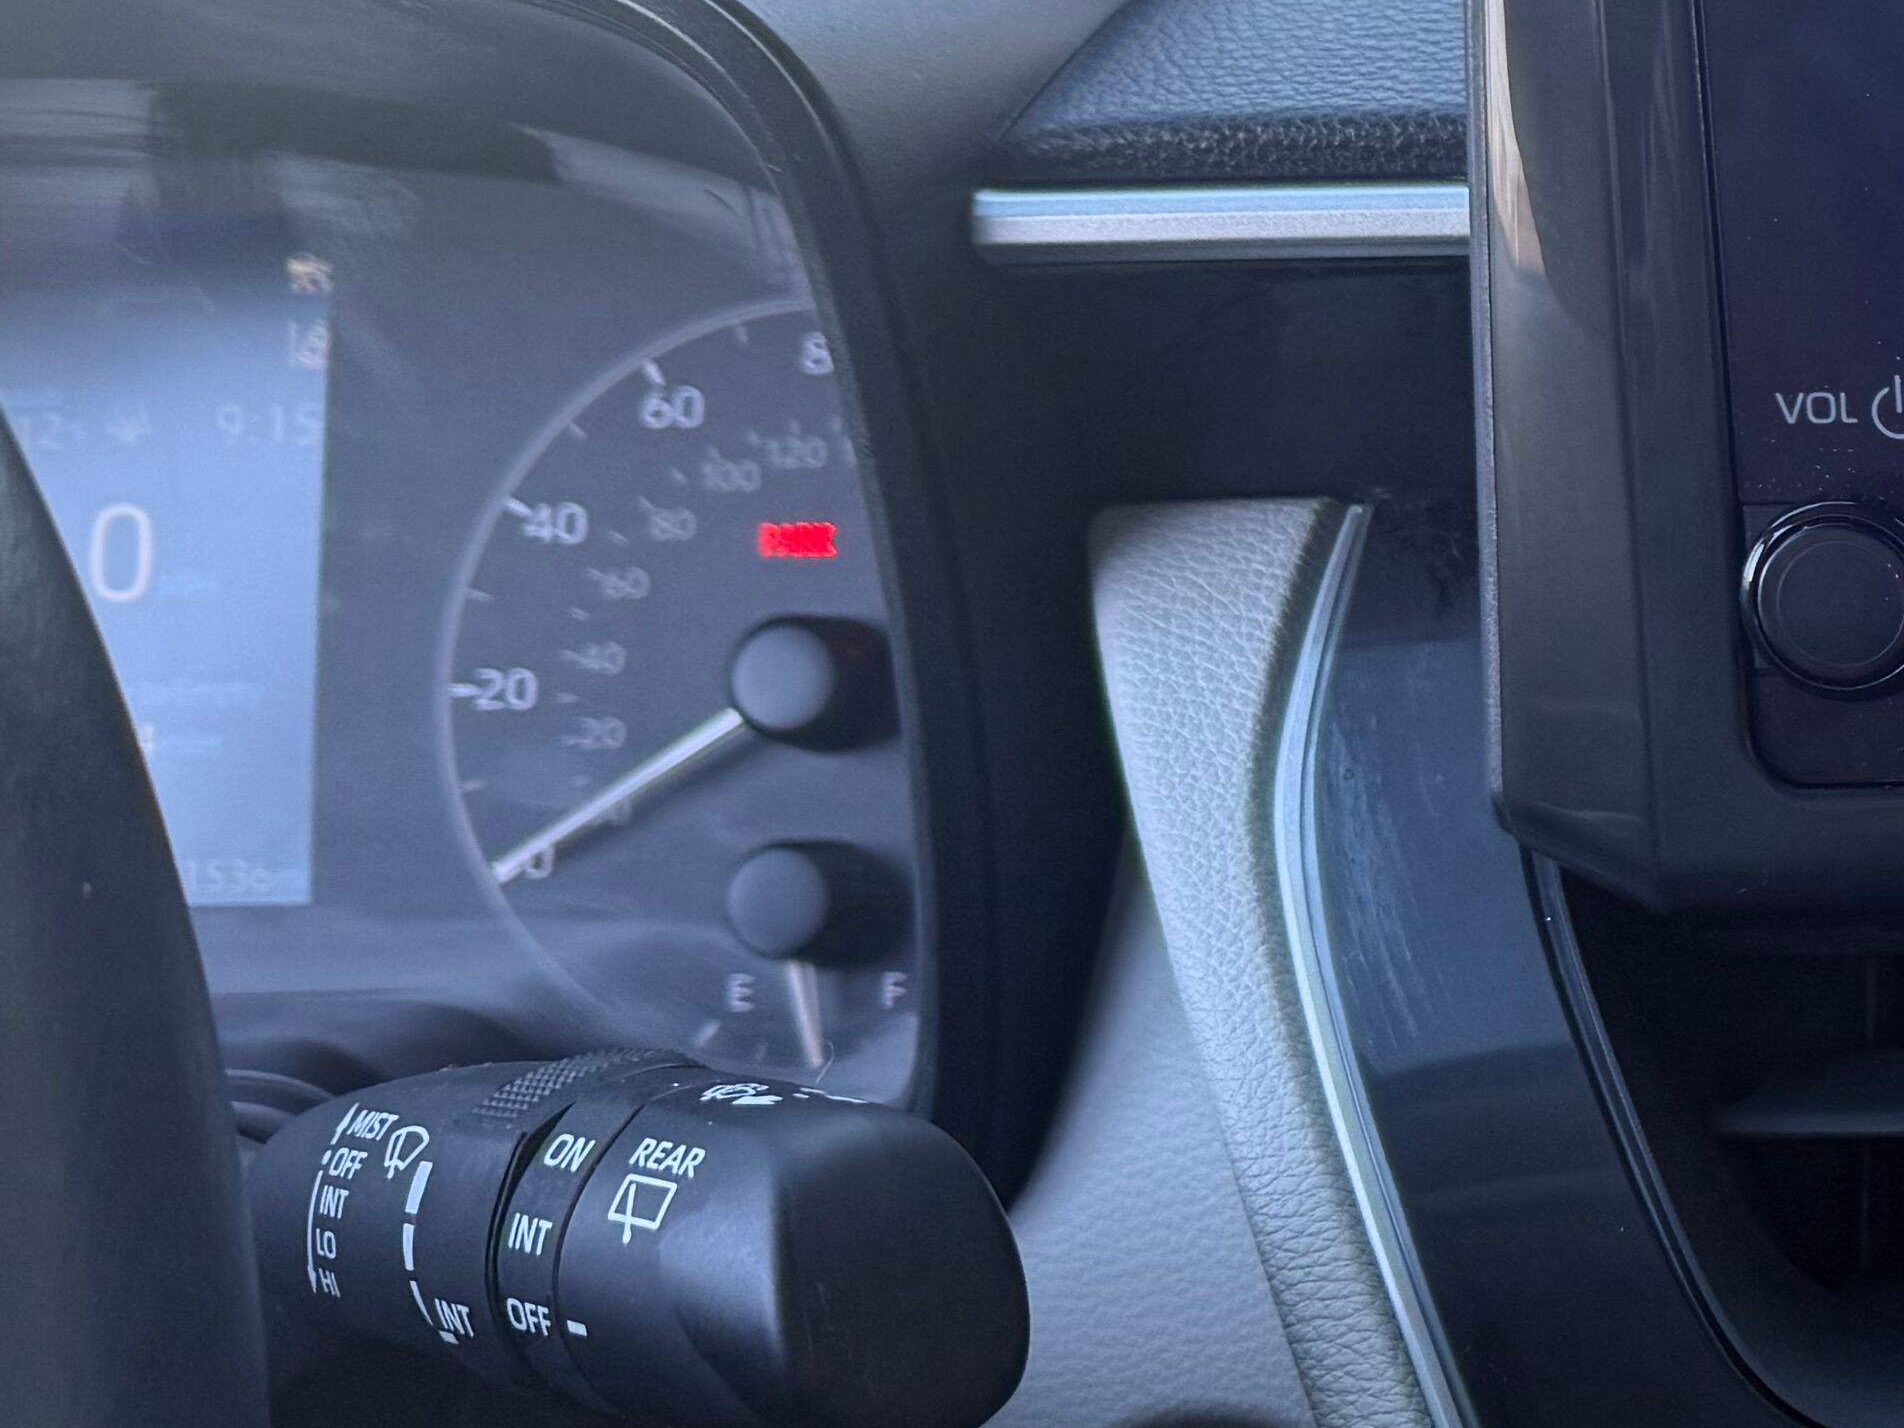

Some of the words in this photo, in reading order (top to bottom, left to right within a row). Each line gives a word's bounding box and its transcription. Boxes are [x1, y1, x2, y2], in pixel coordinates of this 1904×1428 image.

[642, 385, 705, 430] 60
[1775, 392, 1858, 424] VOL
[524, 502, 588, 544] 40
[90, 502, 152, 604] 0
[474, 668, 538, 711] 20
[730, 972, 755, 1012] E
[883, 971, 906, 1009] F
[347, 1110, 399, 1141] MIST
[329, 1148, 368, 1179] OFF
[544, 1134, 596, 1172] ON
[630, 1138, 706, 1179] REAR
[319, 1185, 349, 1219] INT
[316, 1228, 336, 1259] LO
[508, 1213, 552, 1256] INT
[319, 1268, 341, 1298] HI
[435, 1298, 474, 1338] INT
[507, 1298, 551, 1336] OFF
